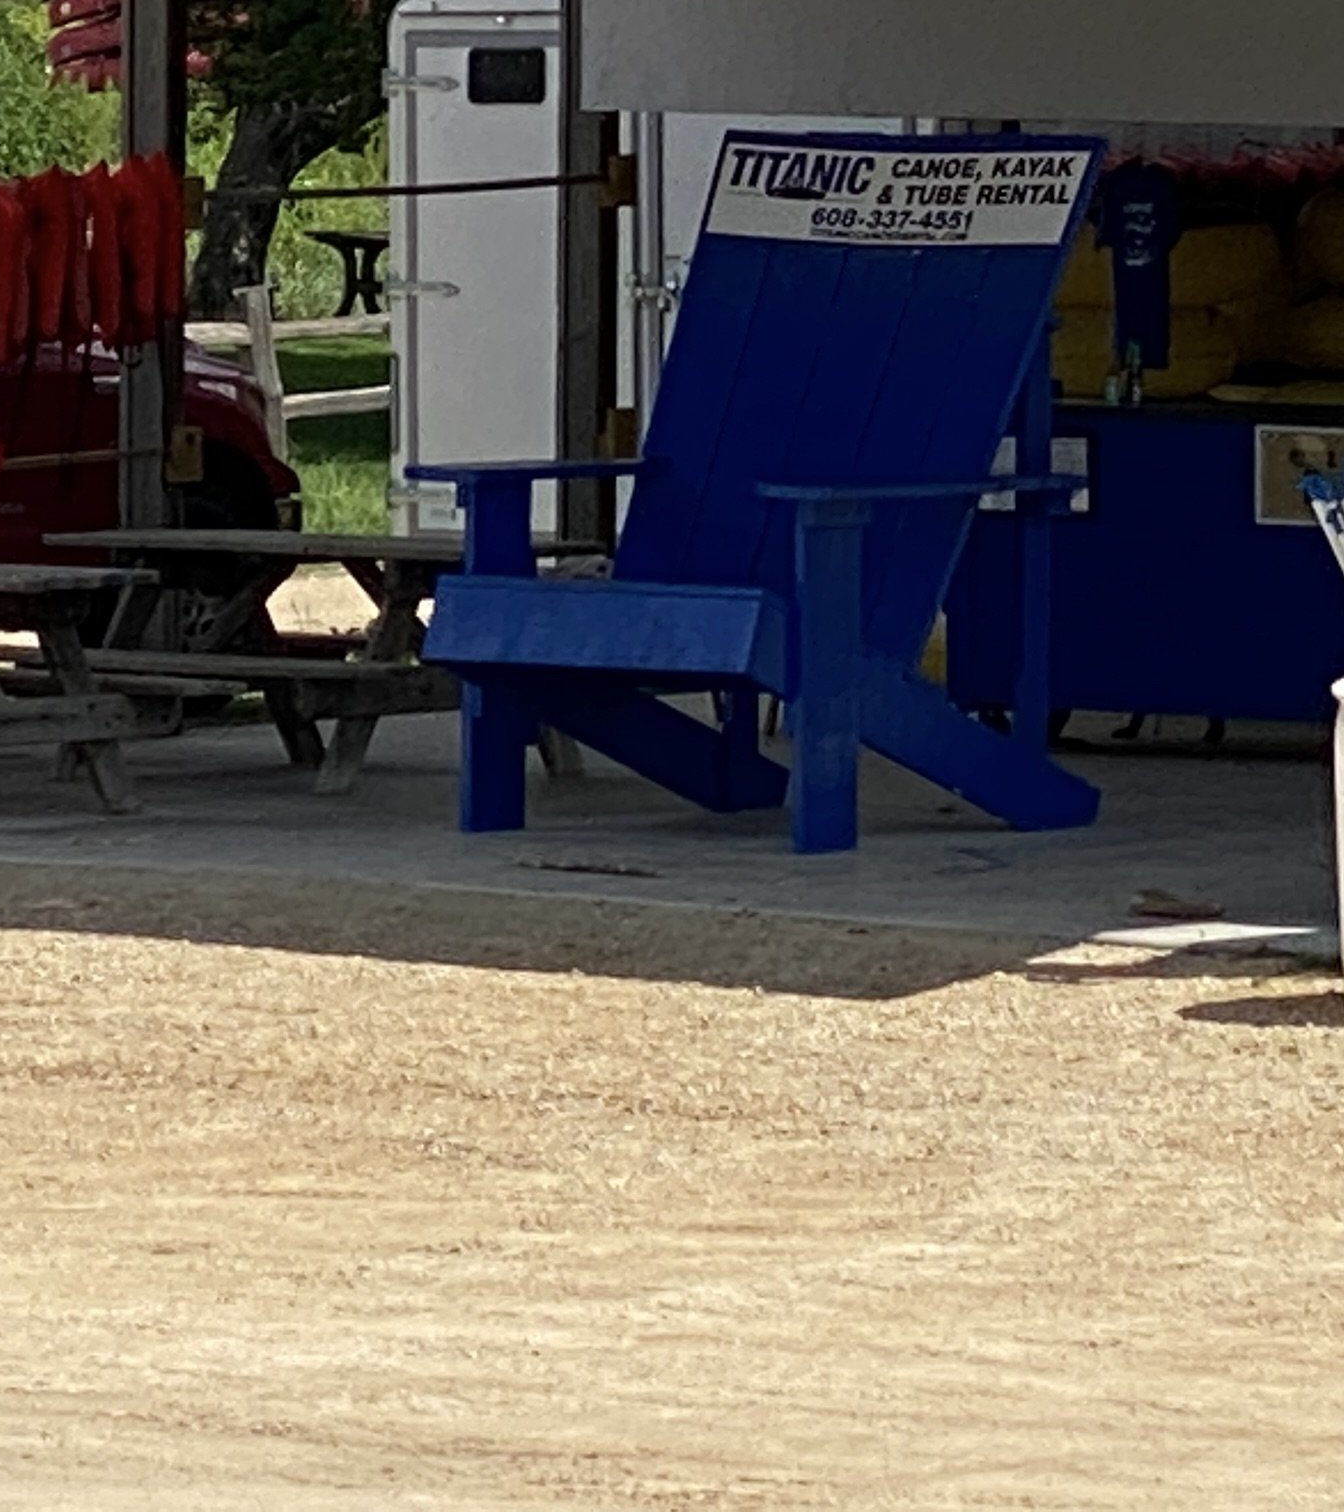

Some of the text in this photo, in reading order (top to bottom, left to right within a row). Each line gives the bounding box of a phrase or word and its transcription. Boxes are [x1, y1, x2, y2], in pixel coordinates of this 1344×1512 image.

[729, 148, 1077, 196] TITANIC CANOE, KAYAK
[876, 184, 1071, 207] & TUBE RENTAL
[811, 206, 973, 232] 608-337-4551
